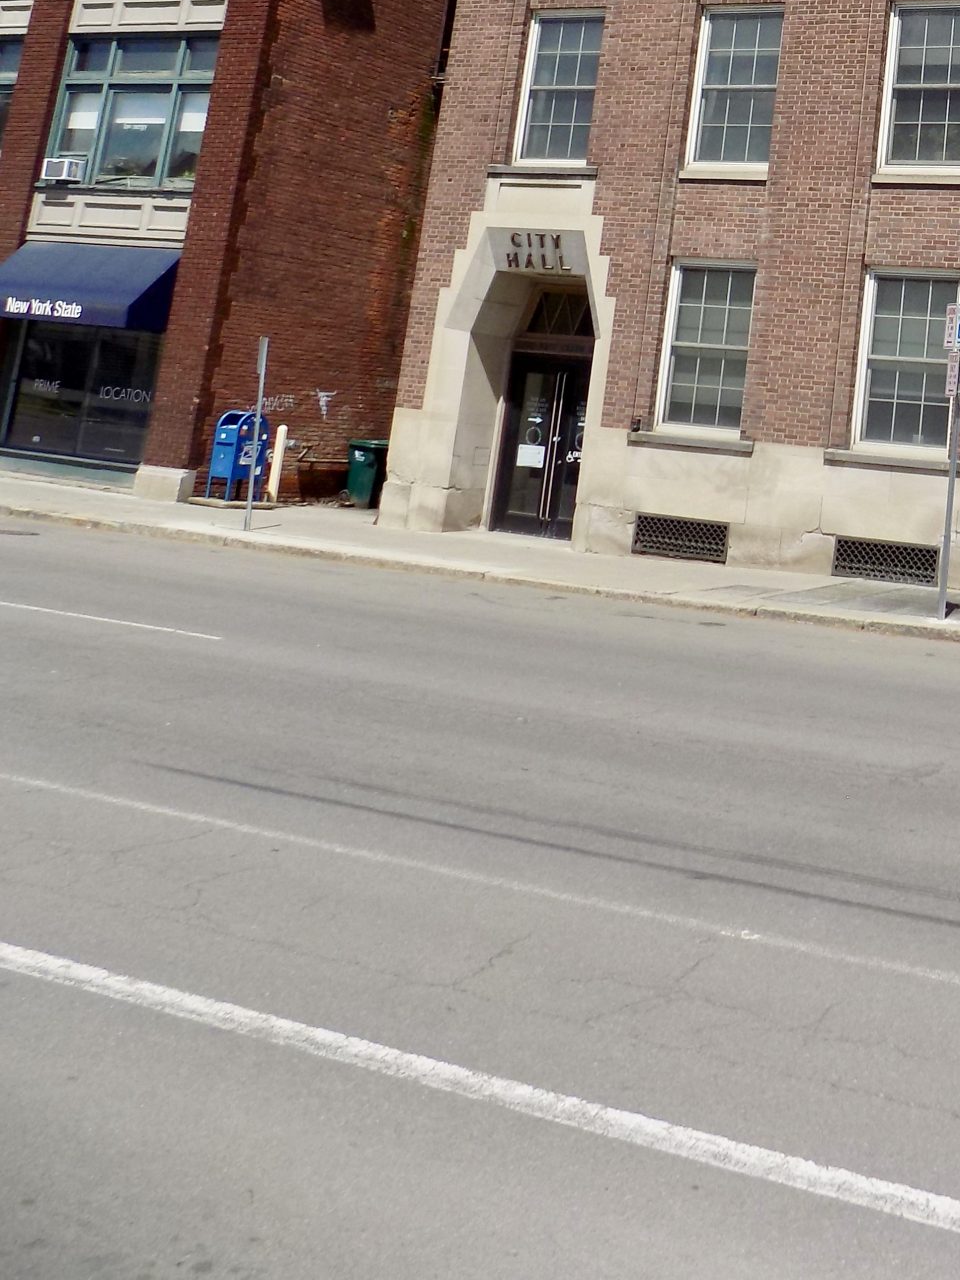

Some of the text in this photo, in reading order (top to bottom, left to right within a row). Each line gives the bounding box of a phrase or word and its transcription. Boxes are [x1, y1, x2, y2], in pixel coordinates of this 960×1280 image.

[511, 232, 561, 249] CITY
[506, 252, 572, 270] HALL
[5, 297, 82, 318] New York State
[34, 379, 151, 403] PRIME LOCATION
